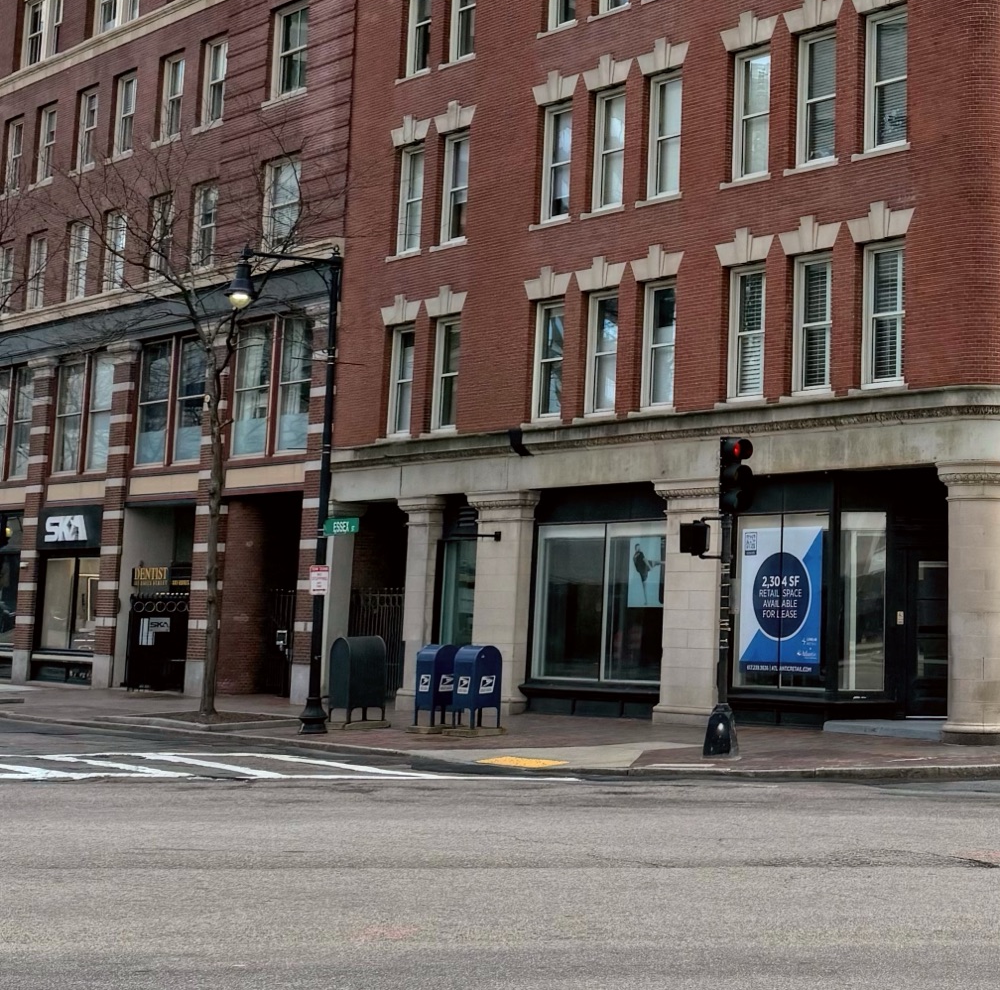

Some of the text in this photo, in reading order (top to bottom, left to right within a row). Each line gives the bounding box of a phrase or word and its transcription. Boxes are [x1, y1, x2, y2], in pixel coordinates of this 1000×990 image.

[44, 515, 87, 542] SKA
[333, 521, 349, 532] ESSEX
[134, 567, 168, 580] DENTIST
[762, 575, 800, 589] 2,304 SF
[758, 588, 802, 598] RETAIL SPACE
[763, 599, 798, 608] AVAILABLE
[762, 610, 798, 619] FOR LEASE
